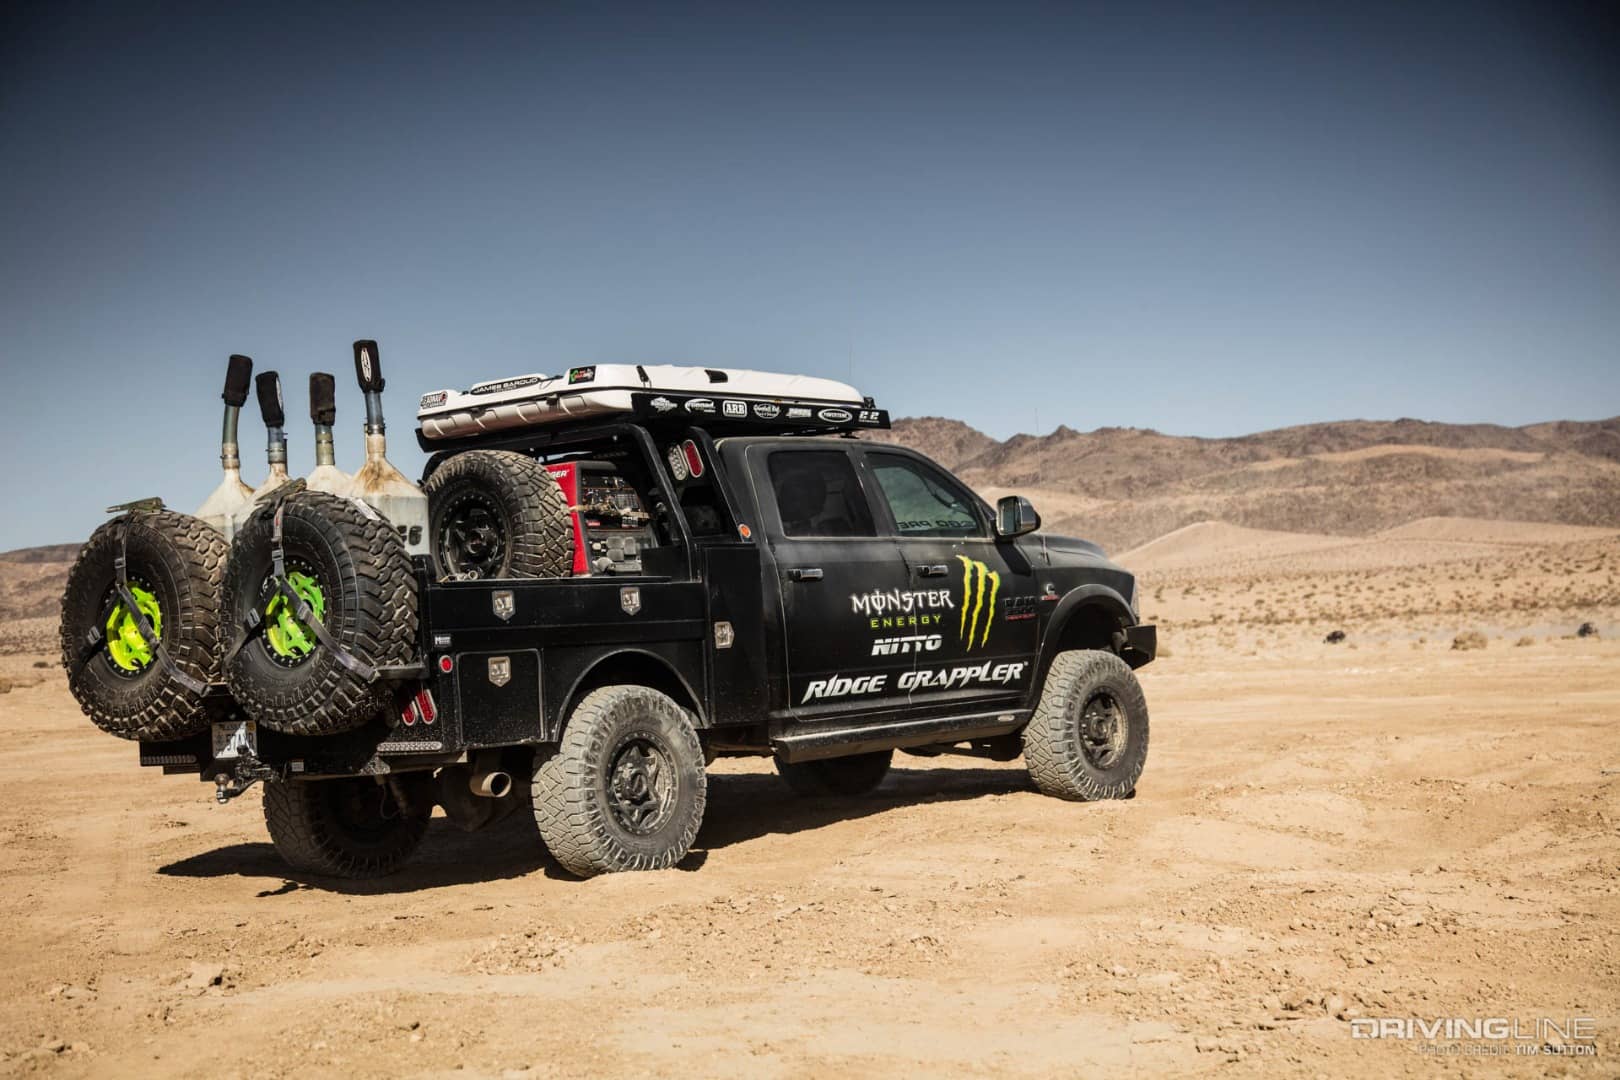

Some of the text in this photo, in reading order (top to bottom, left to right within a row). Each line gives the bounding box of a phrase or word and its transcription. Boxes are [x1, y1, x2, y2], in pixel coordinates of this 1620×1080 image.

[474, 384, 501, 394] JAMES
[503, 378, 538, 388] BAROUD
[726, 403, 745, 415] ARB
[851, 588, 956, 616] MONSTER
[870, 614, 942, 629] ENERGY
[871, 633, 943, 656] NITTO
[801, 660, 1025, 704] RIDGE GRAPPLER
